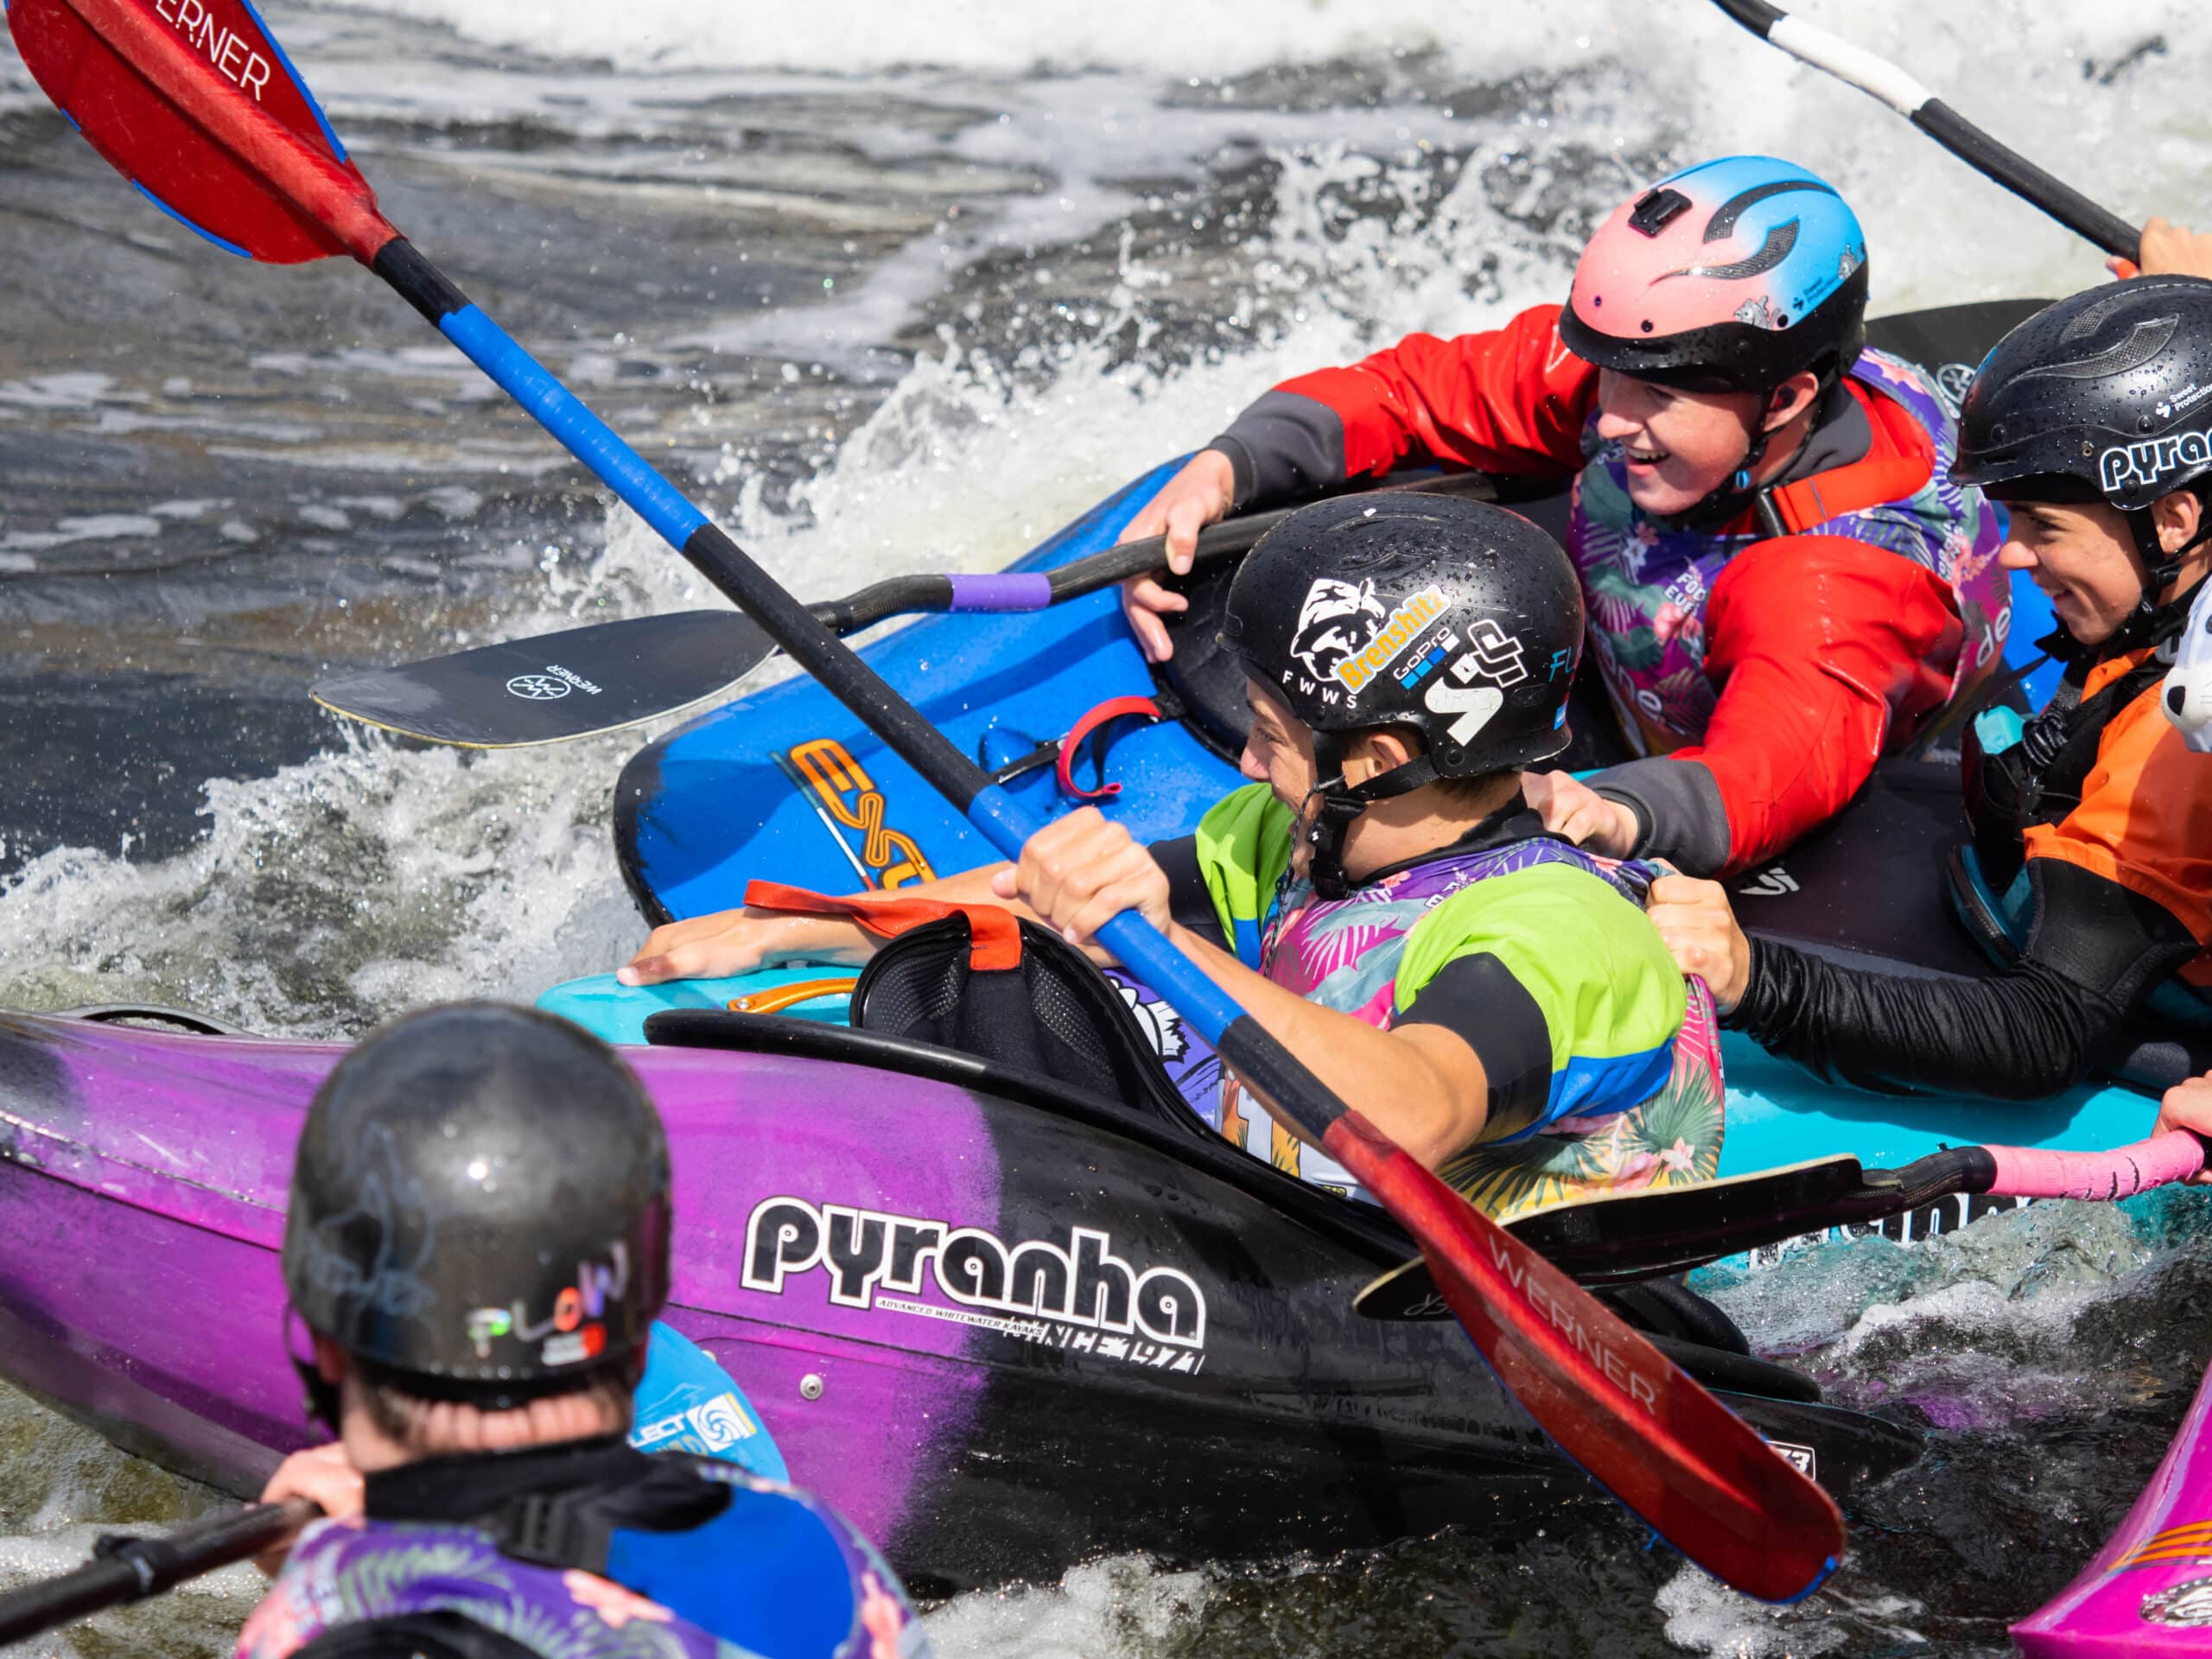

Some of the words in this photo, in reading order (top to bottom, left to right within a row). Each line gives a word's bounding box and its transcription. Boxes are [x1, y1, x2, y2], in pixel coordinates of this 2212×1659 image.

[2174, 384, 2212, 411] Protectio
[2100, 427, 2212, 492] pyra
[545, 664, 602, 696] WERNER
[1393, 626, 1451, 681] GoPro
[741, 1196, 1208, 1348] pyranha
[879, 1300, 933, 1315] ADVANCED
[935, 1309, 1002, 1328] WHITEWATER
[1002, 1322, 1044, 1337] KAYAKS
[1488, 1233, 1656, 1416] WERNER
